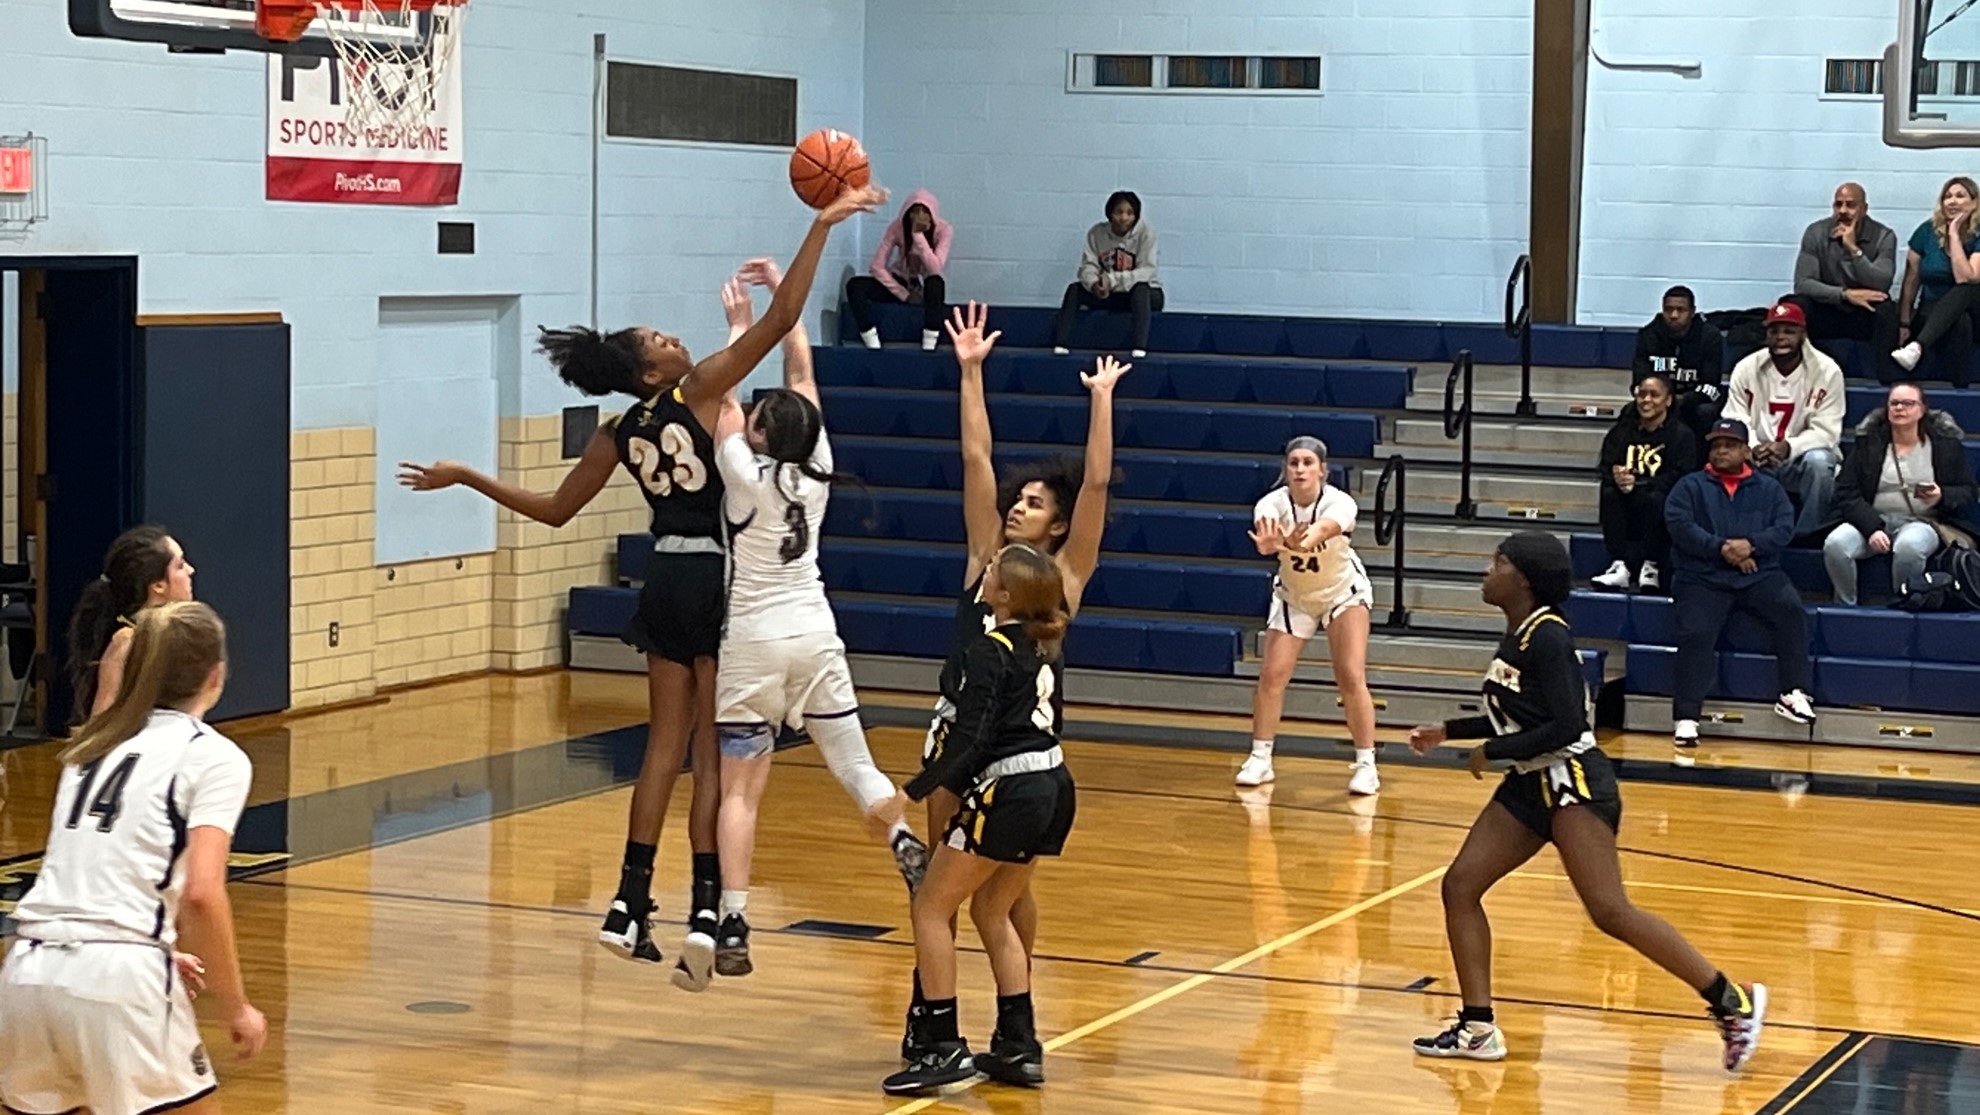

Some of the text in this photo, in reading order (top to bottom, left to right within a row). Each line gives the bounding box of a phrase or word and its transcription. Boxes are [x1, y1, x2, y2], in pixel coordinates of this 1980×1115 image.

[280, 119, 357, 148] SPORTS
[334, 172, 401, 193] PivotHS.com
[1768, 402, 1796, 442] 7
[628, 422, 707, 497] 23
[778, 501, 809, 565] 3
[1291, 556, 1320, 573] 24
[65, 752, 142, 834] 14
